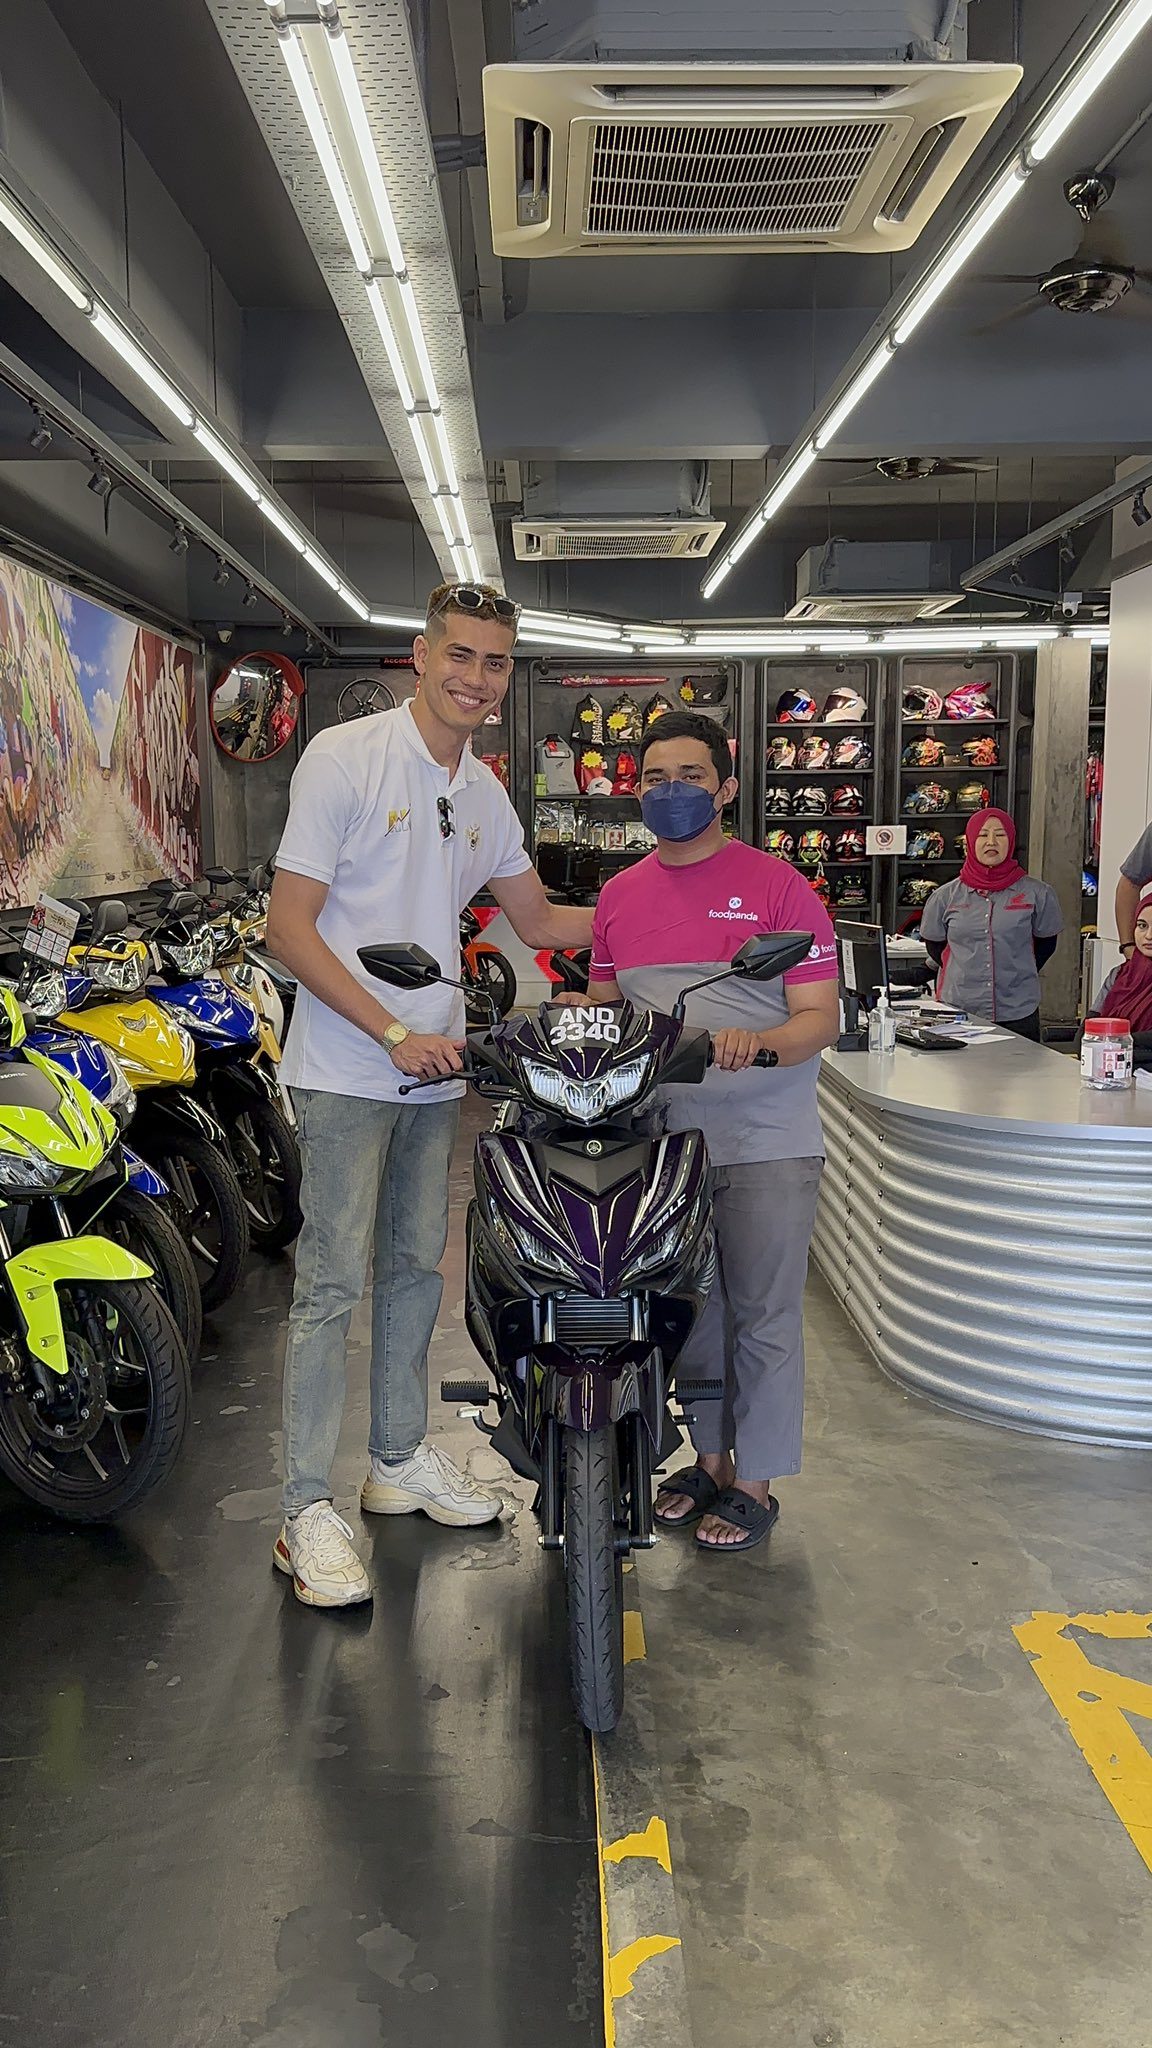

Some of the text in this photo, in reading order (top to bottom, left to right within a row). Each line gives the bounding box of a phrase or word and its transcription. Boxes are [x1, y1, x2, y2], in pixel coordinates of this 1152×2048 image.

[708, 909, 759, 921] foodpanda
[821, 944, 837, 954] food
[558, 1007, 614, 1026] AND
[549, 1022, 621, 1046] 3340
[18, 1264, 47, 1277] ABS
